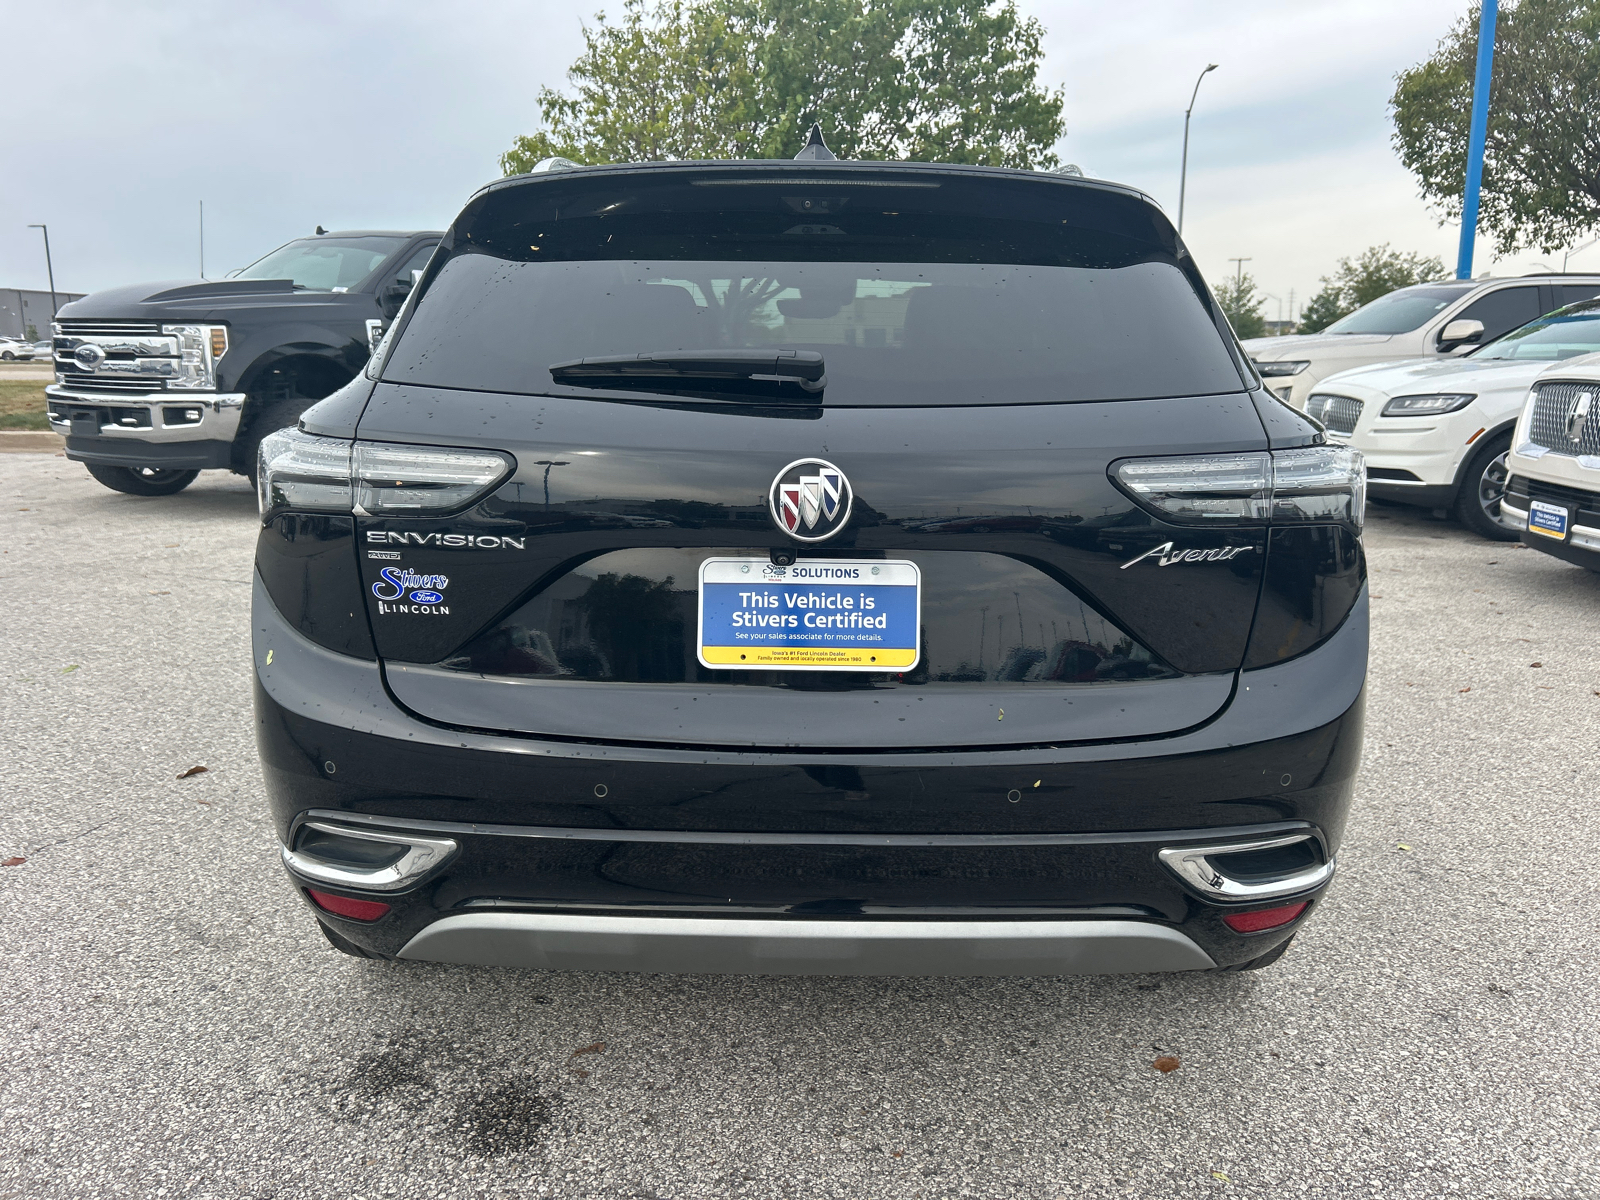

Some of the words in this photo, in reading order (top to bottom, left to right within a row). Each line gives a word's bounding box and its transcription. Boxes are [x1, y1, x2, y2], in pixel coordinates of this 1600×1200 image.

[366, 530, 526, 550] ENVISION
[1119, 541, 1254, 570] Avenir
[792, 568, 860, 578] SOLUTIONS
[371, 566, 449, 600] Stivers
[416, 592, 437, 602] Ford
[739, 592, 779, 608] This
[784, 592, 854, 609] Vehicle
[860, 593, 875, 610] is
[384, 603, 450, 615] LINCOLN
[732, 610, 798, 628] Stivers
[804, 612, 887, 629] Certified
